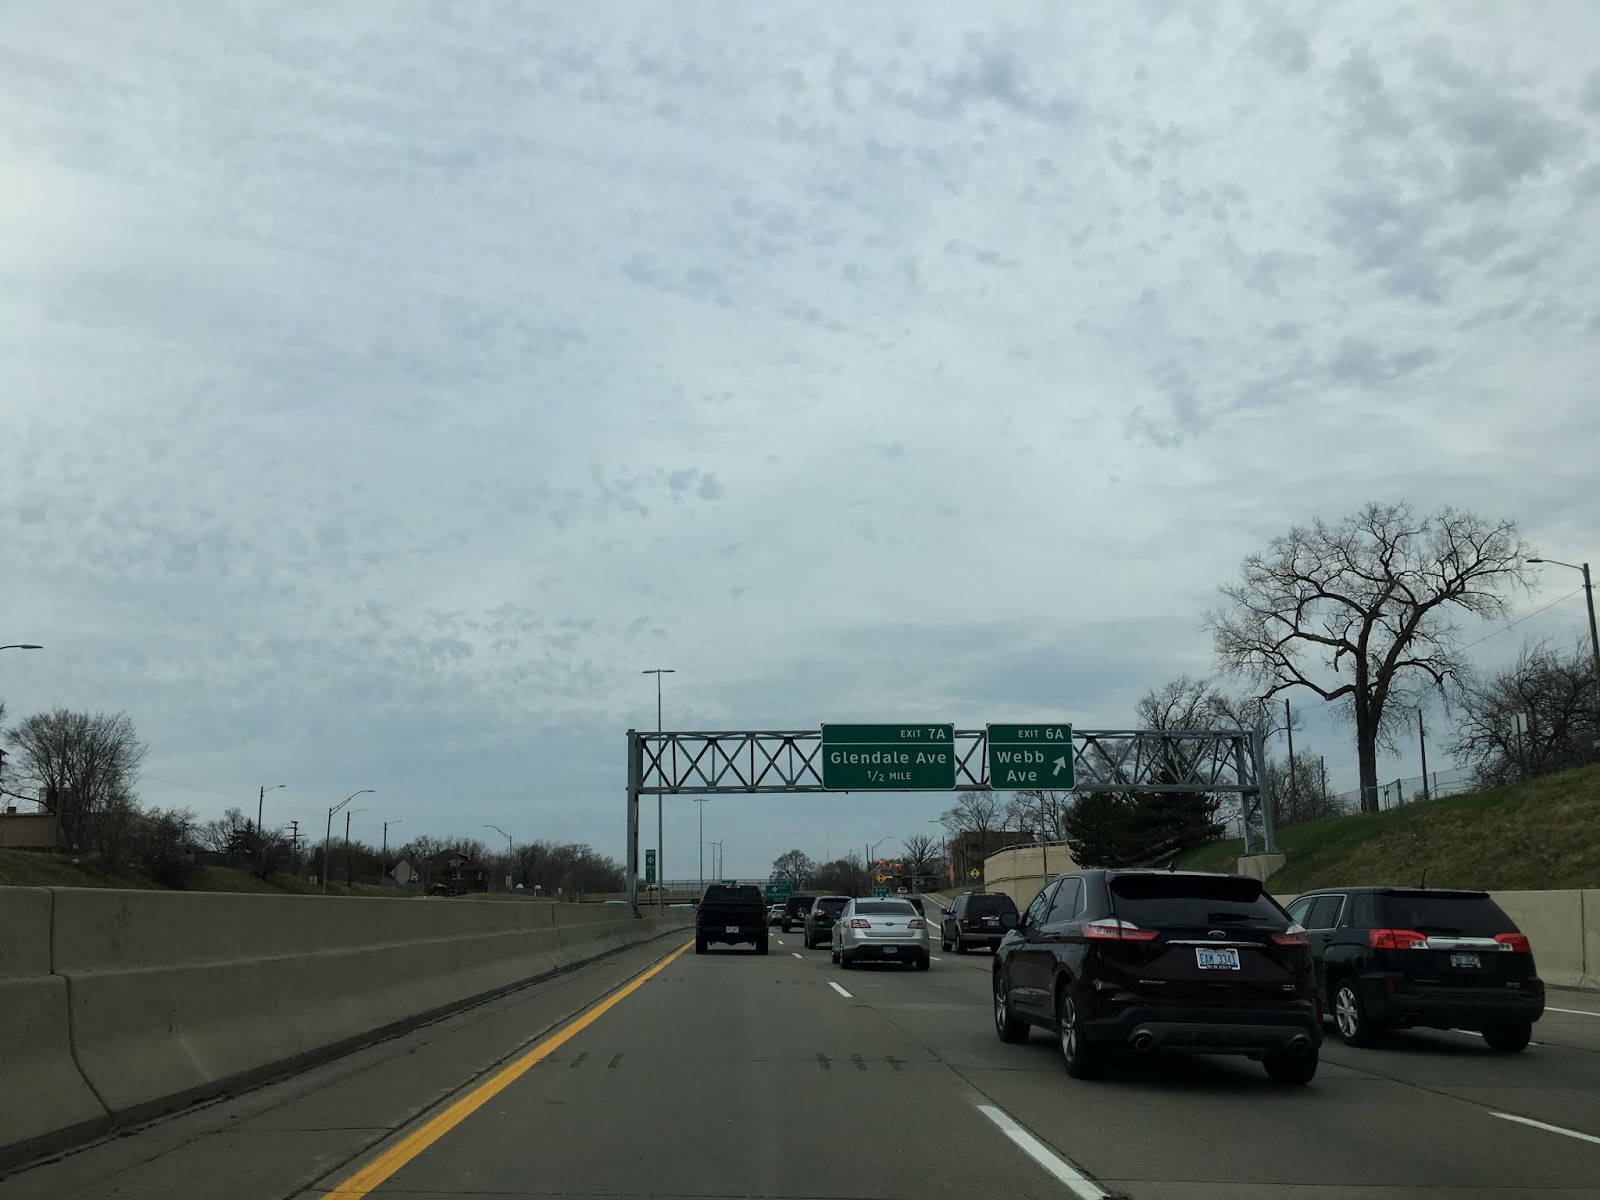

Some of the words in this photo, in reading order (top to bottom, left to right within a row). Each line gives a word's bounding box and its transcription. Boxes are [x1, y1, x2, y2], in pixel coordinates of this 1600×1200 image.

[900, 730, 921, 738] EXIT
[928, 728, 946, 739] 7A
[1018, 730, 1039, 738] EXIT
[1045, 728, 1064, 740] 6A
[830, 751, 909, 764] Glendale
[916, 752, 947, 764] Ave
[996, 750, 1044, 763] Webb
[867, 770, 885, 782] 1/2
[889, 772, 912, 780] MILE
[1006, 769, 1037, 782] Ave
